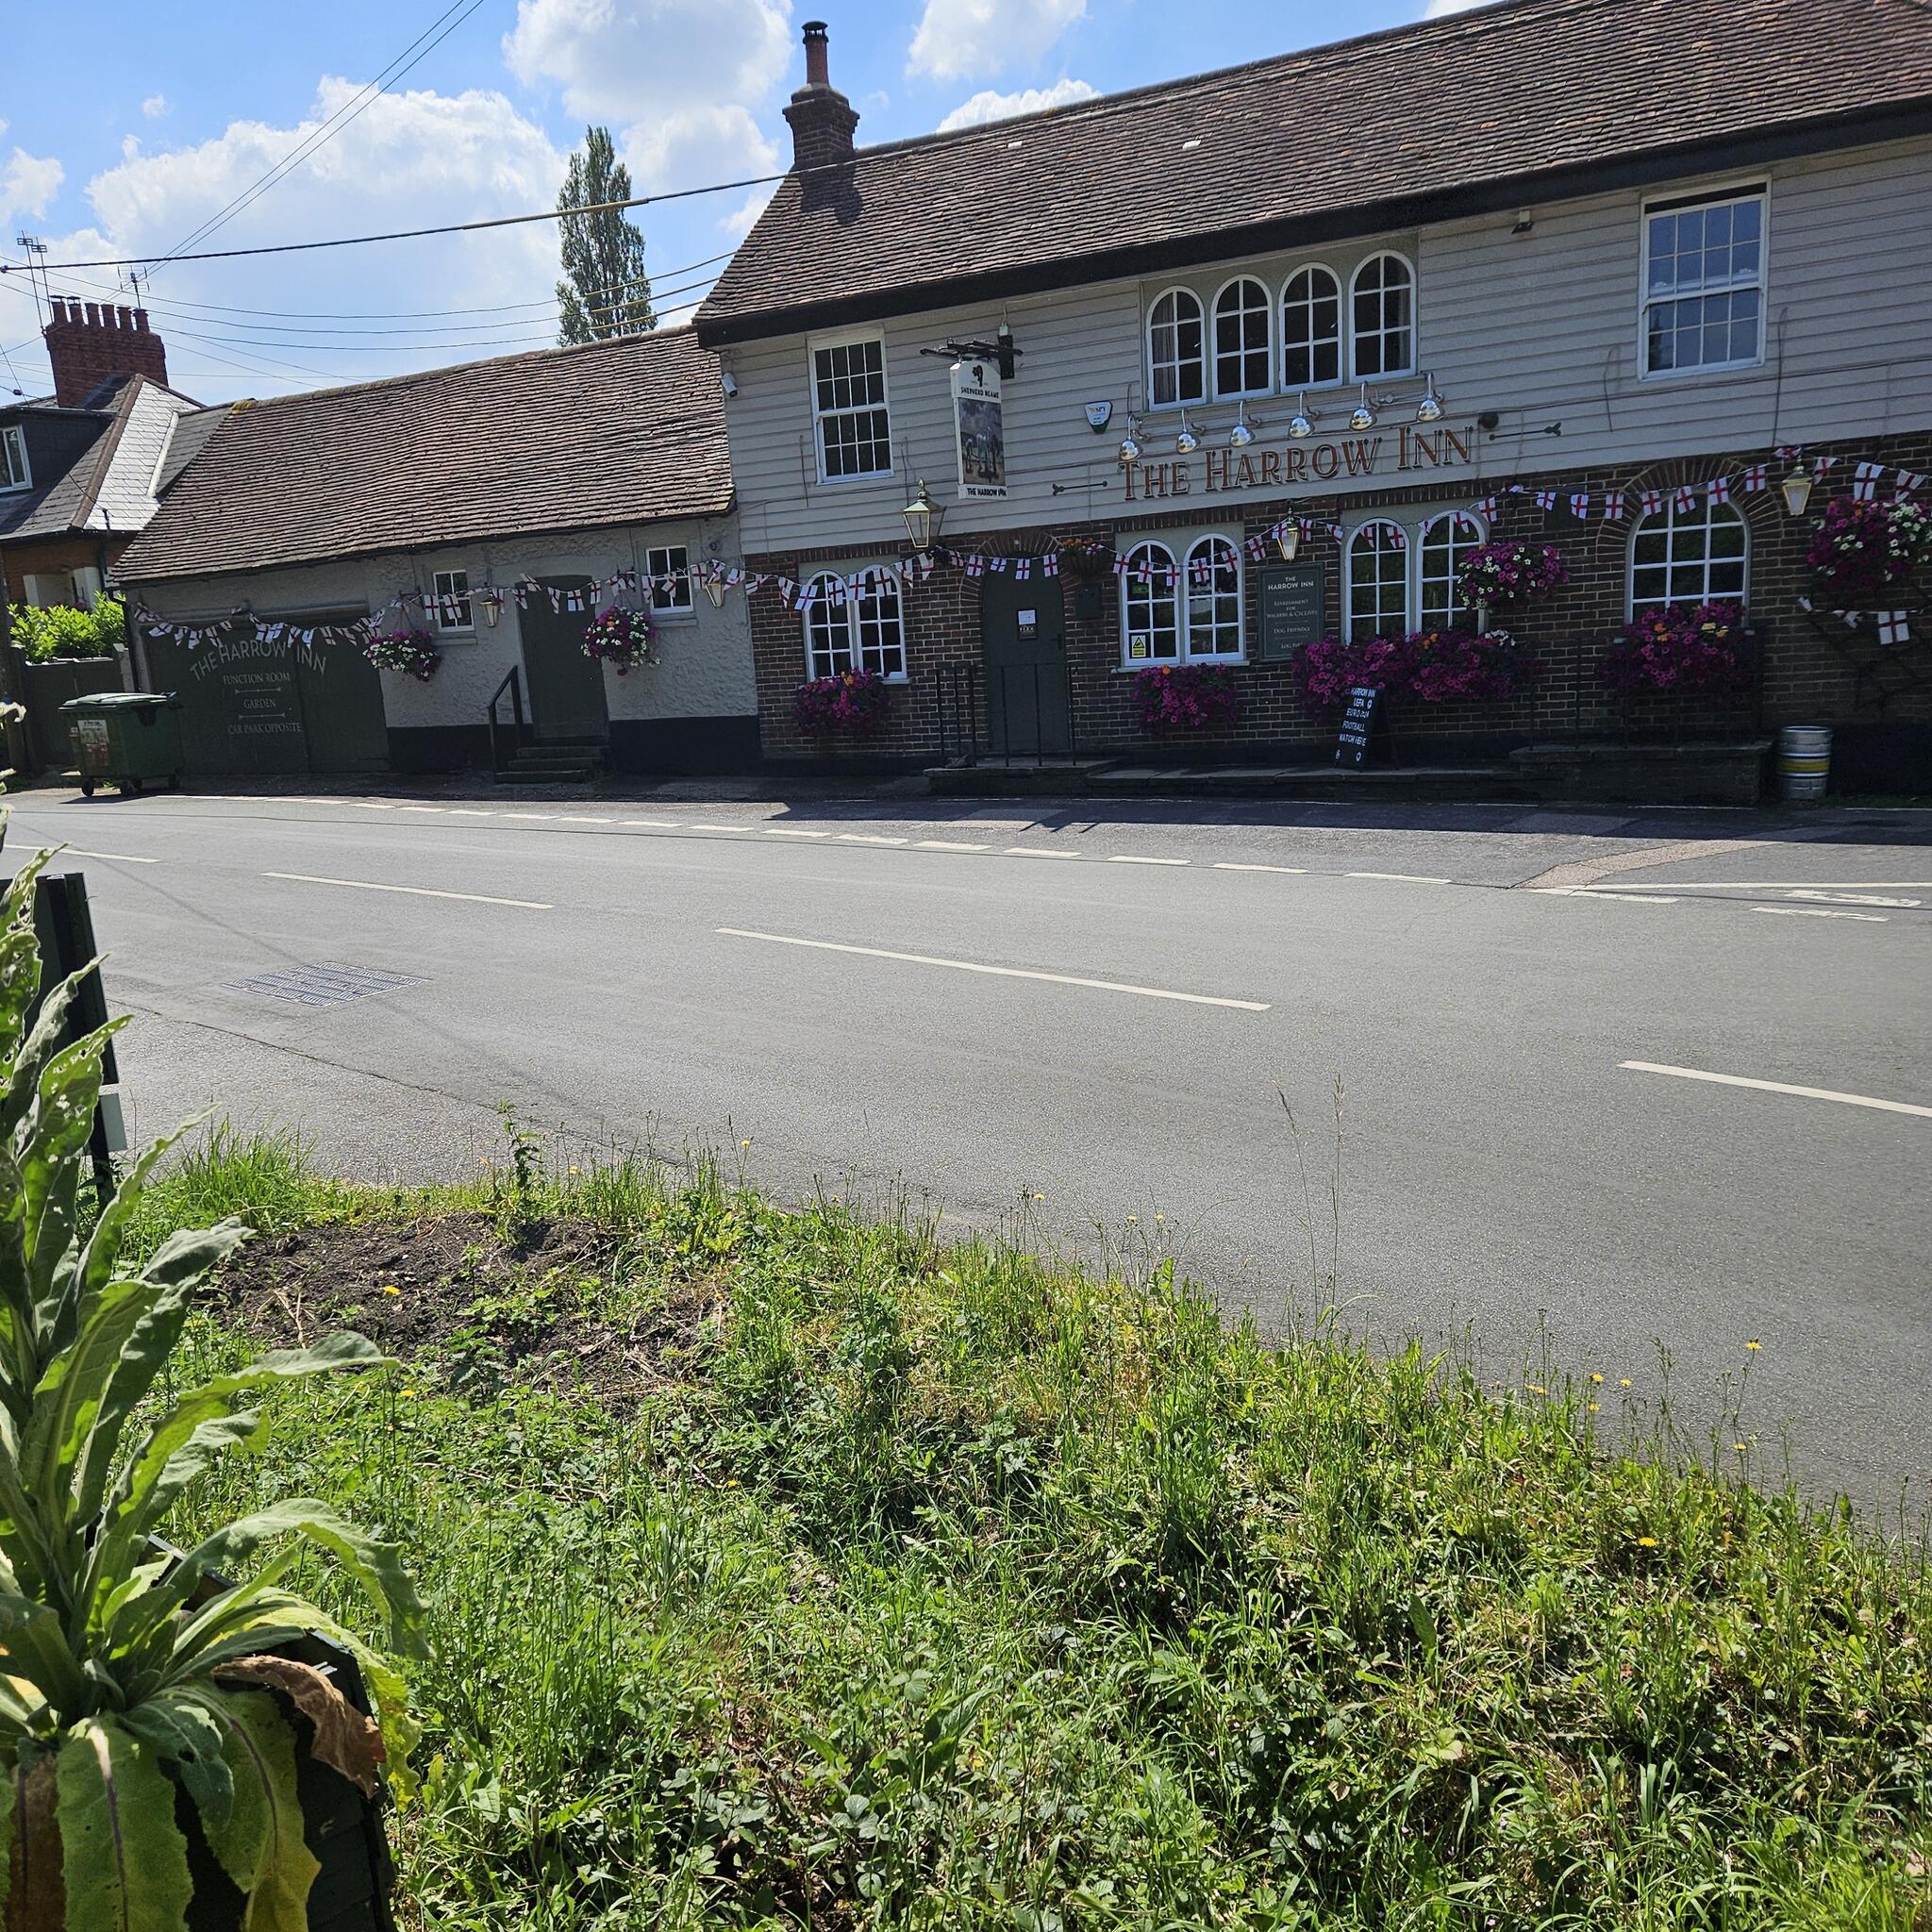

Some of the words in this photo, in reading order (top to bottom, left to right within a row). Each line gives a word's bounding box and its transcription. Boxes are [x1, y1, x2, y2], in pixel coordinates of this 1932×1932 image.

[960, 386, 984, 396] SHEPHERD
[984, 390, 1000, 399] NEAME
[1118, 459, 1191, 501] THE
[1204, 437, 1383, 492] HARROW
[1397, 425, 1474, 471] INN
[966, 487, 977, 496] THE
[977, 488, 998, 496] HARROW
[998, 488, 1008, 497] INN
[1267, 582, 1299, 591] HARROW
[190, 651, 218, 681] THE
[217, 641, 287, 664] HARROW
[295, 645, 327, 675] INN
[223, 673, 264, 685] FUNCTION
[264, 671, 291, 683] ROOM
[242, 697, 277, 709] GARDEN
[1354, 697, 1364, 708] UEFA
[1346, 708, 1360, 718] EURO
[226, 724, 243, 735] CAR
[242, 723, 264, 734] PARK
[264, 722, 303, 733] OPPOSITE
[1343, 720, 1365, 732] FOOTBALL
